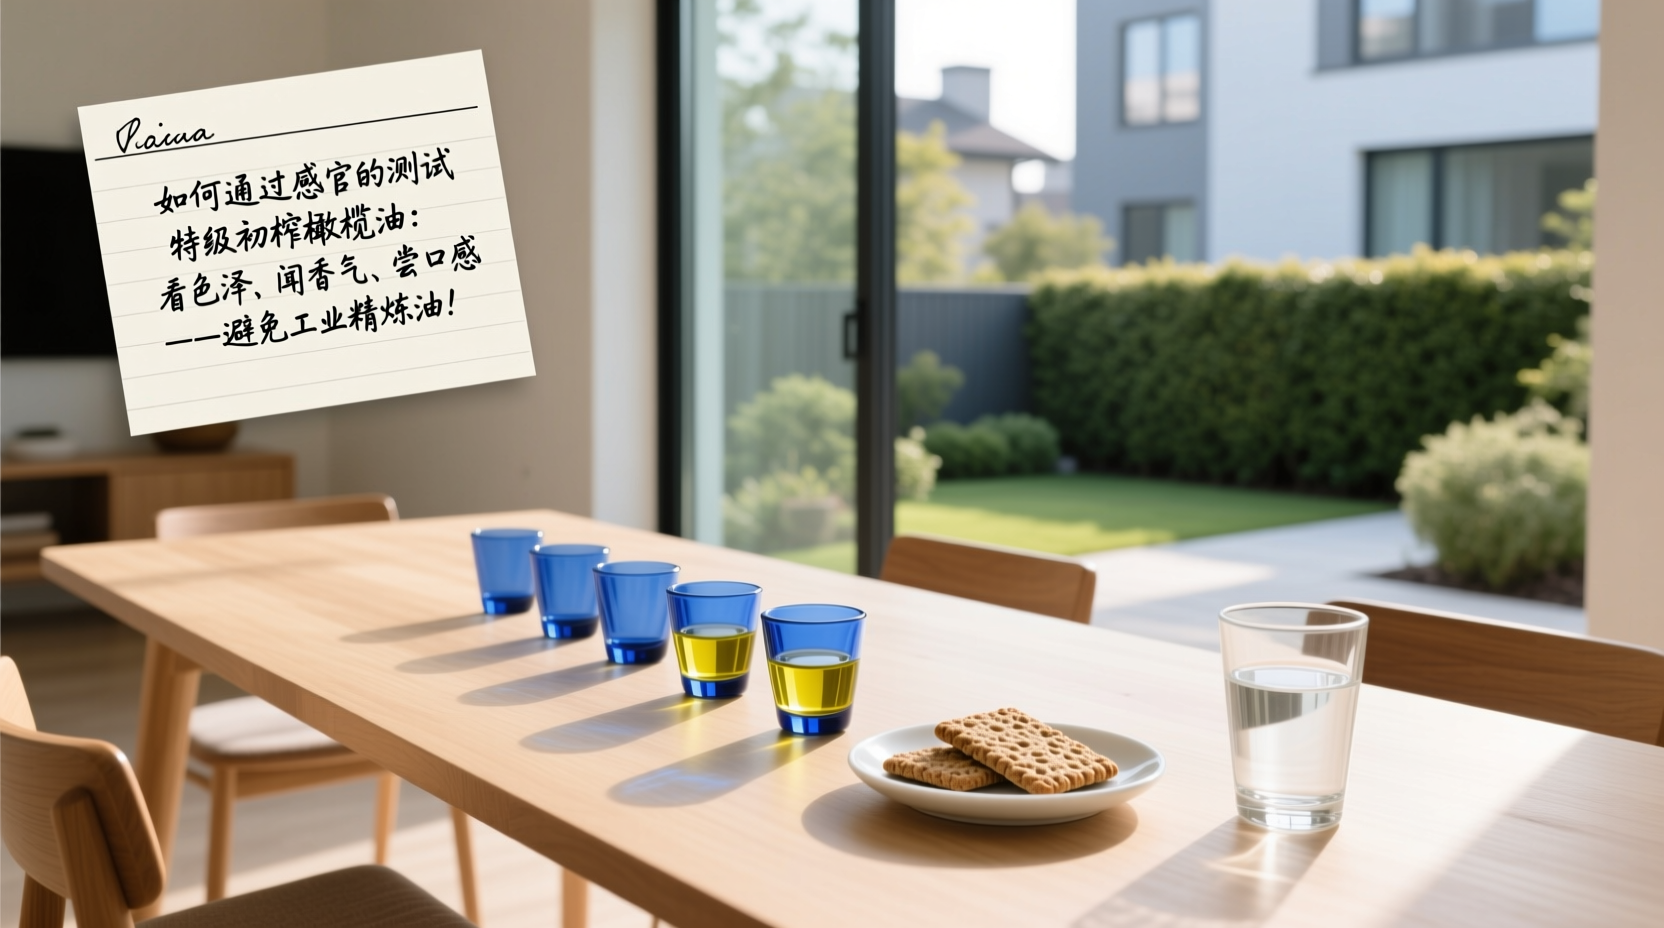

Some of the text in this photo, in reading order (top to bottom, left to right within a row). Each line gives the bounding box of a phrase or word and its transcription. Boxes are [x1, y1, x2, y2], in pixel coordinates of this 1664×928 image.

[153, 147, 455, 215] 如何通过感官的测试
